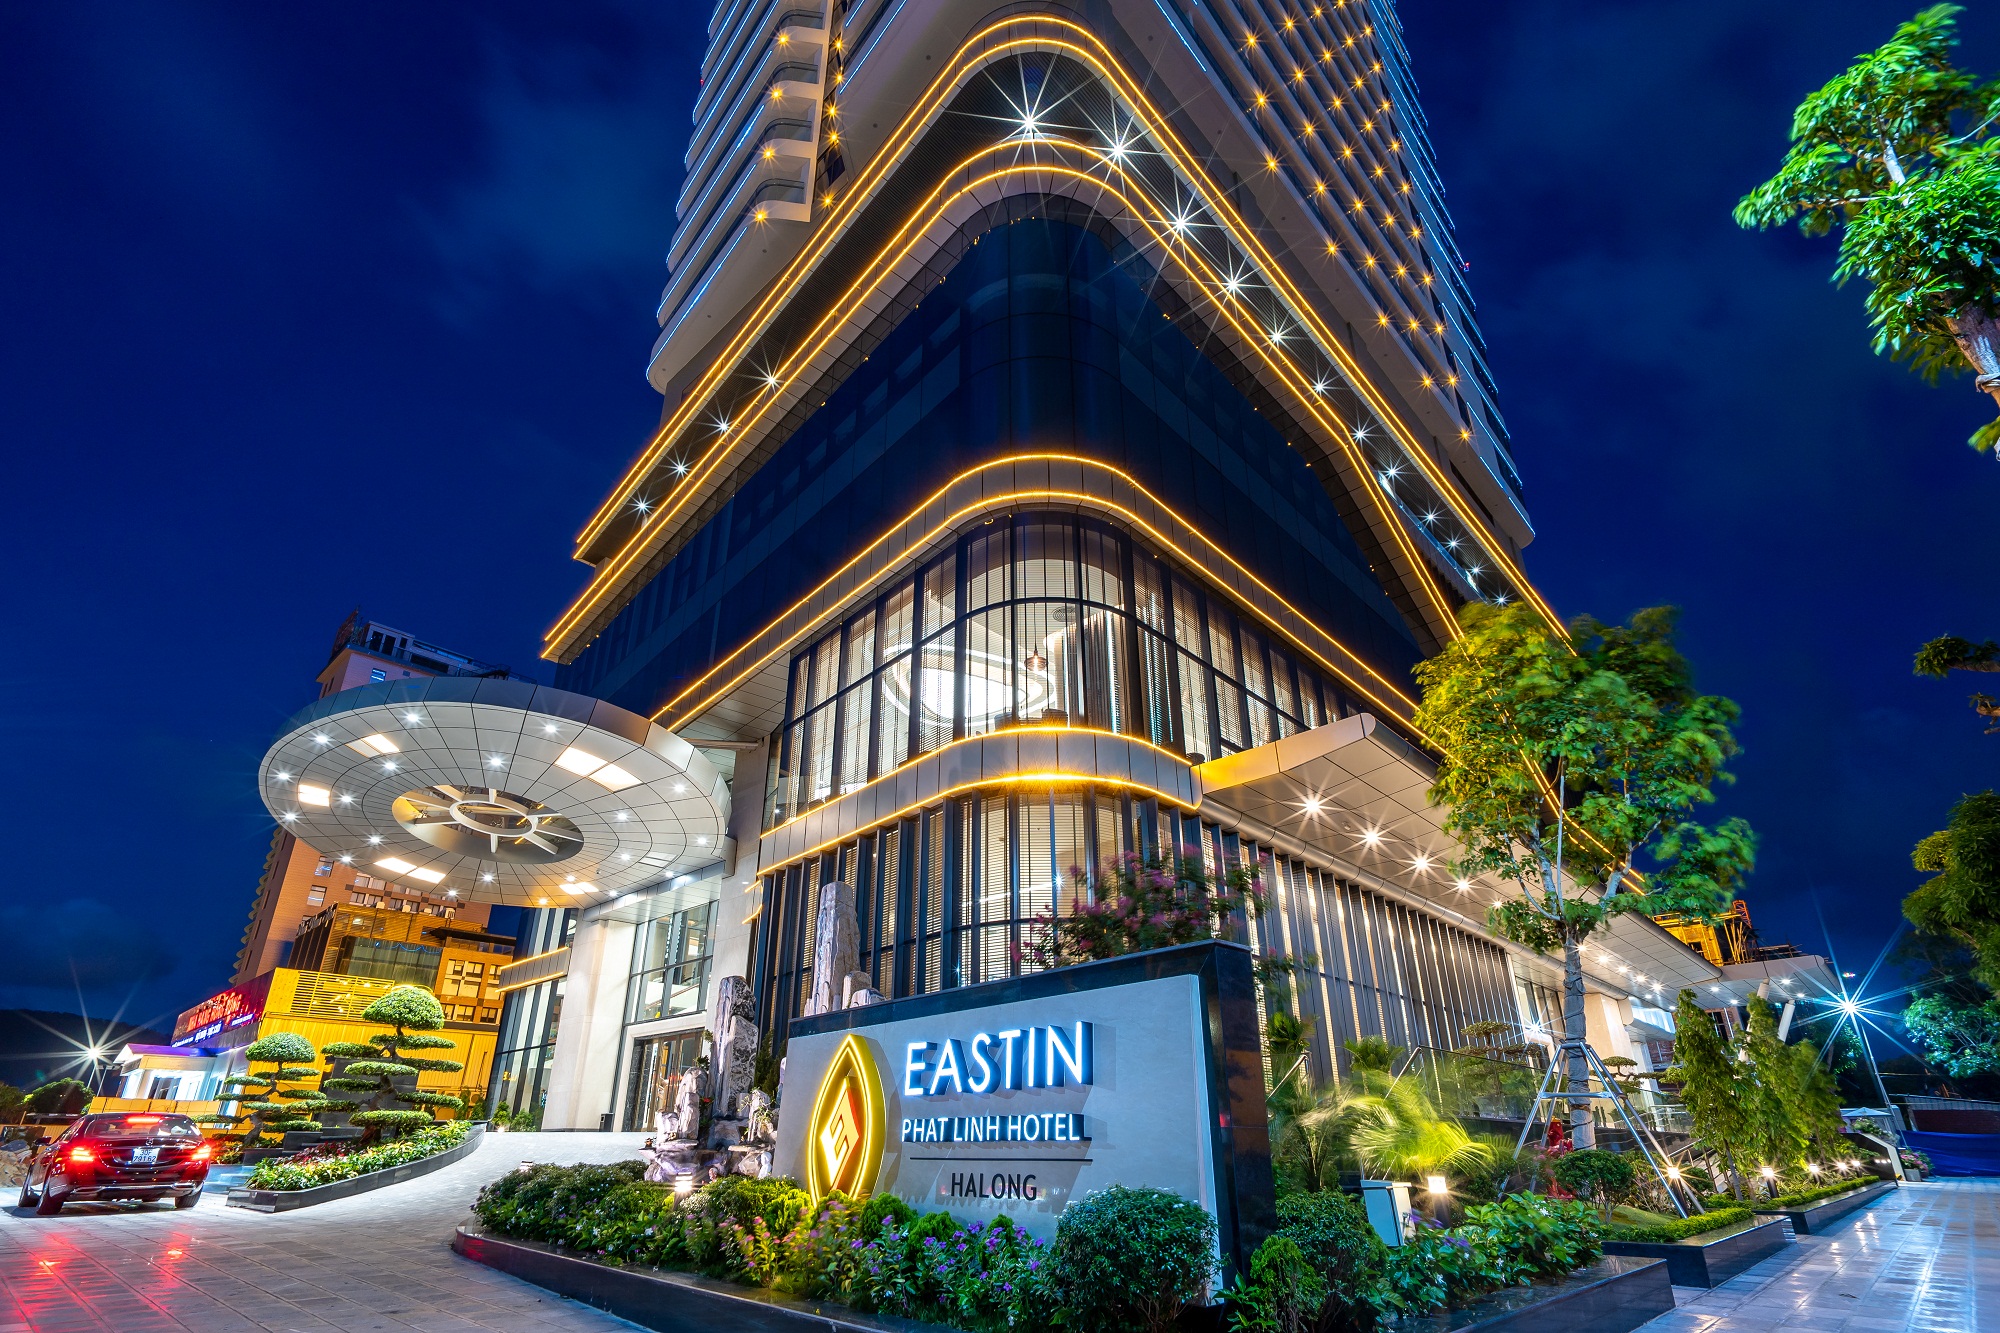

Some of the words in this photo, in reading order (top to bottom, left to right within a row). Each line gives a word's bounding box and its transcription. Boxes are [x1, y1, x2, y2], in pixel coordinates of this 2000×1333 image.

[904, 1020, 1085, 1096] EASTIN
[902, 1117, 949, 1142] PHAT
[953, 1115, 1000, 1142] LINH
[1007, 1113, 1081, 1141] HOTEL
[950, 1172, 1037, 1200] HALONG
